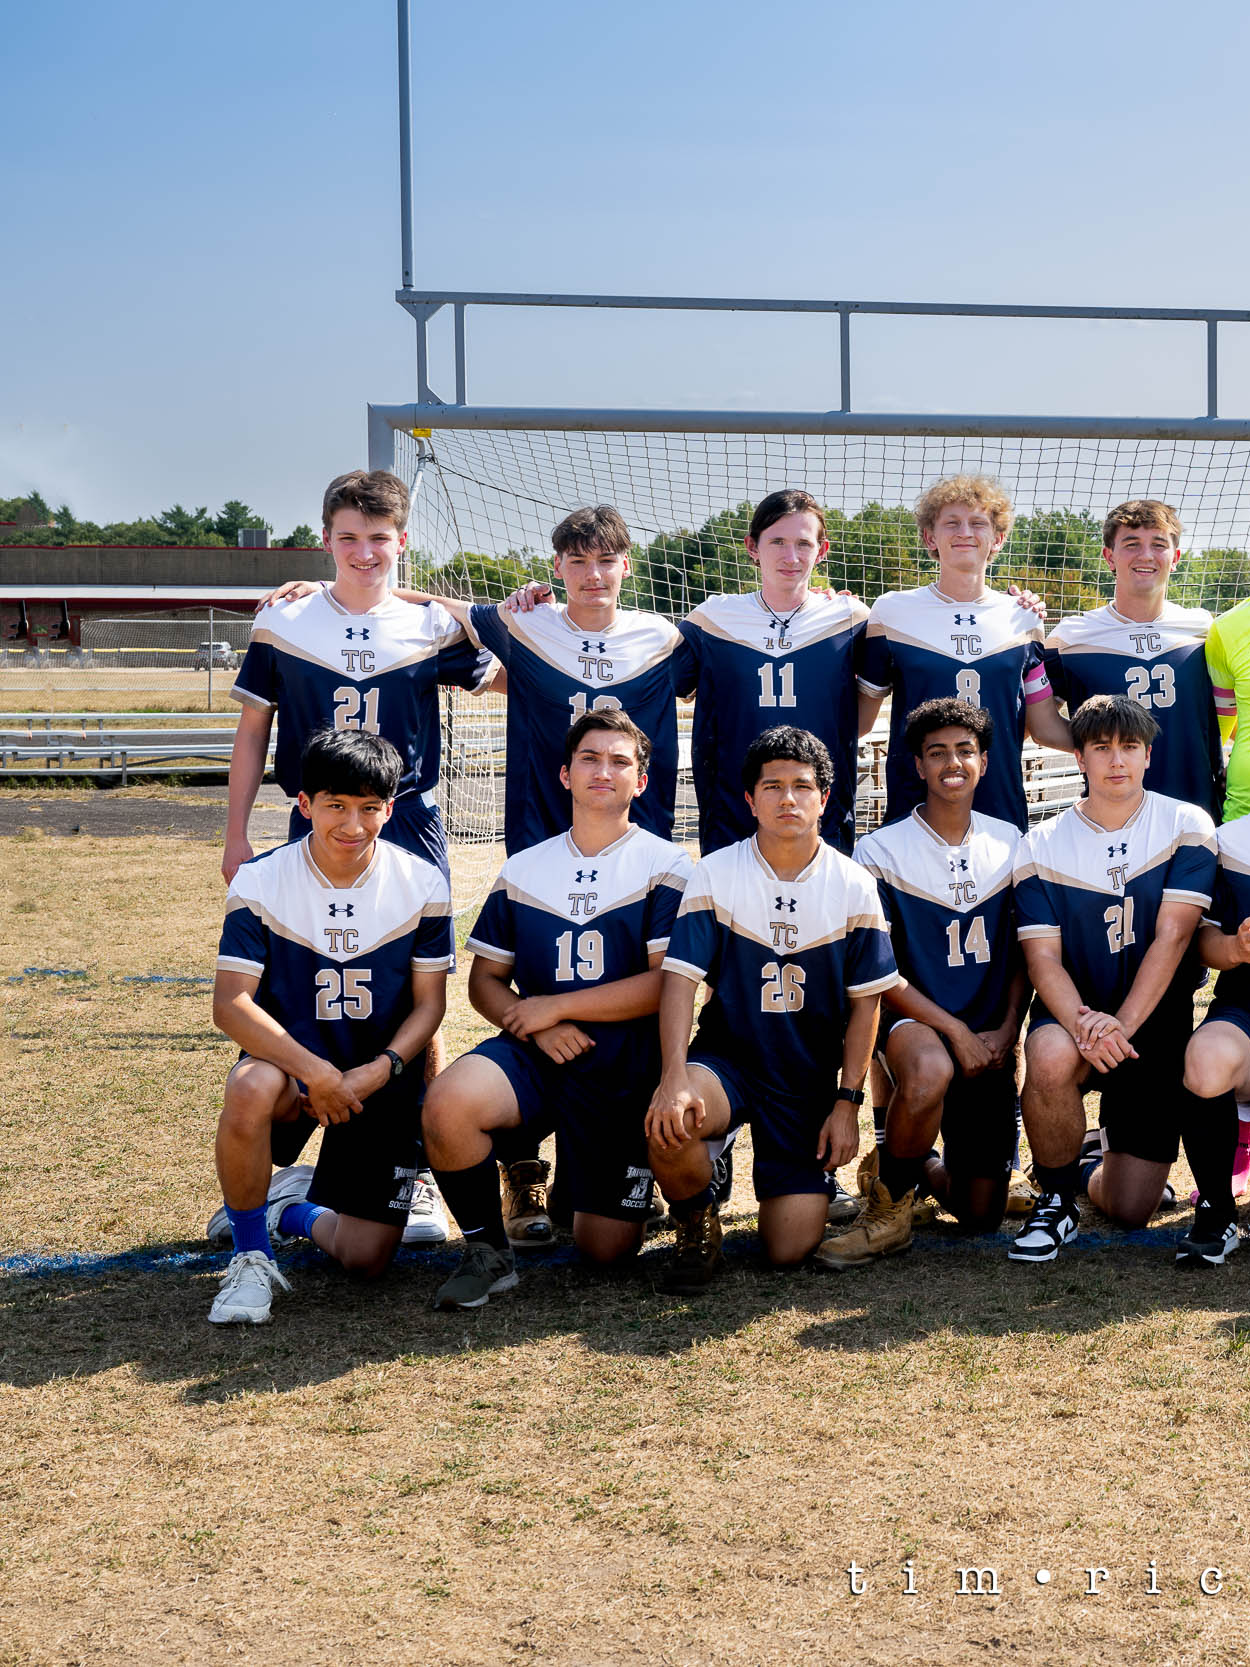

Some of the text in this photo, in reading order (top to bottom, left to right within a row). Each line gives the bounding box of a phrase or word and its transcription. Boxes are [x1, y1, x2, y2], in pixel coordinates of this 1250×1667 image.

[341, 649, 375, 673] TC
[951, 634, 983, 656] TC
[1129, 633, 1161, 654] TC
[578, 655, 614, 682] TC
[758, 662, 797, 707] 11
[955, 668, 981, 710] 8
[1125, 663, 1176, 708] 23
[333, 686, 380, 736] 21
[568, 892, 598, 916] TC
[948, 880, 977, 906] TC
[324, 928, 359, 953] TC
[769, 921, 798, 949] TC
[946, 915, 991, 967] 14
[1104, 896, 1135, 954] 21
[555, 930, 604, 981] 19
[315, 968, 373, 1020] 25
[761, 962, 806, 1013] 26
